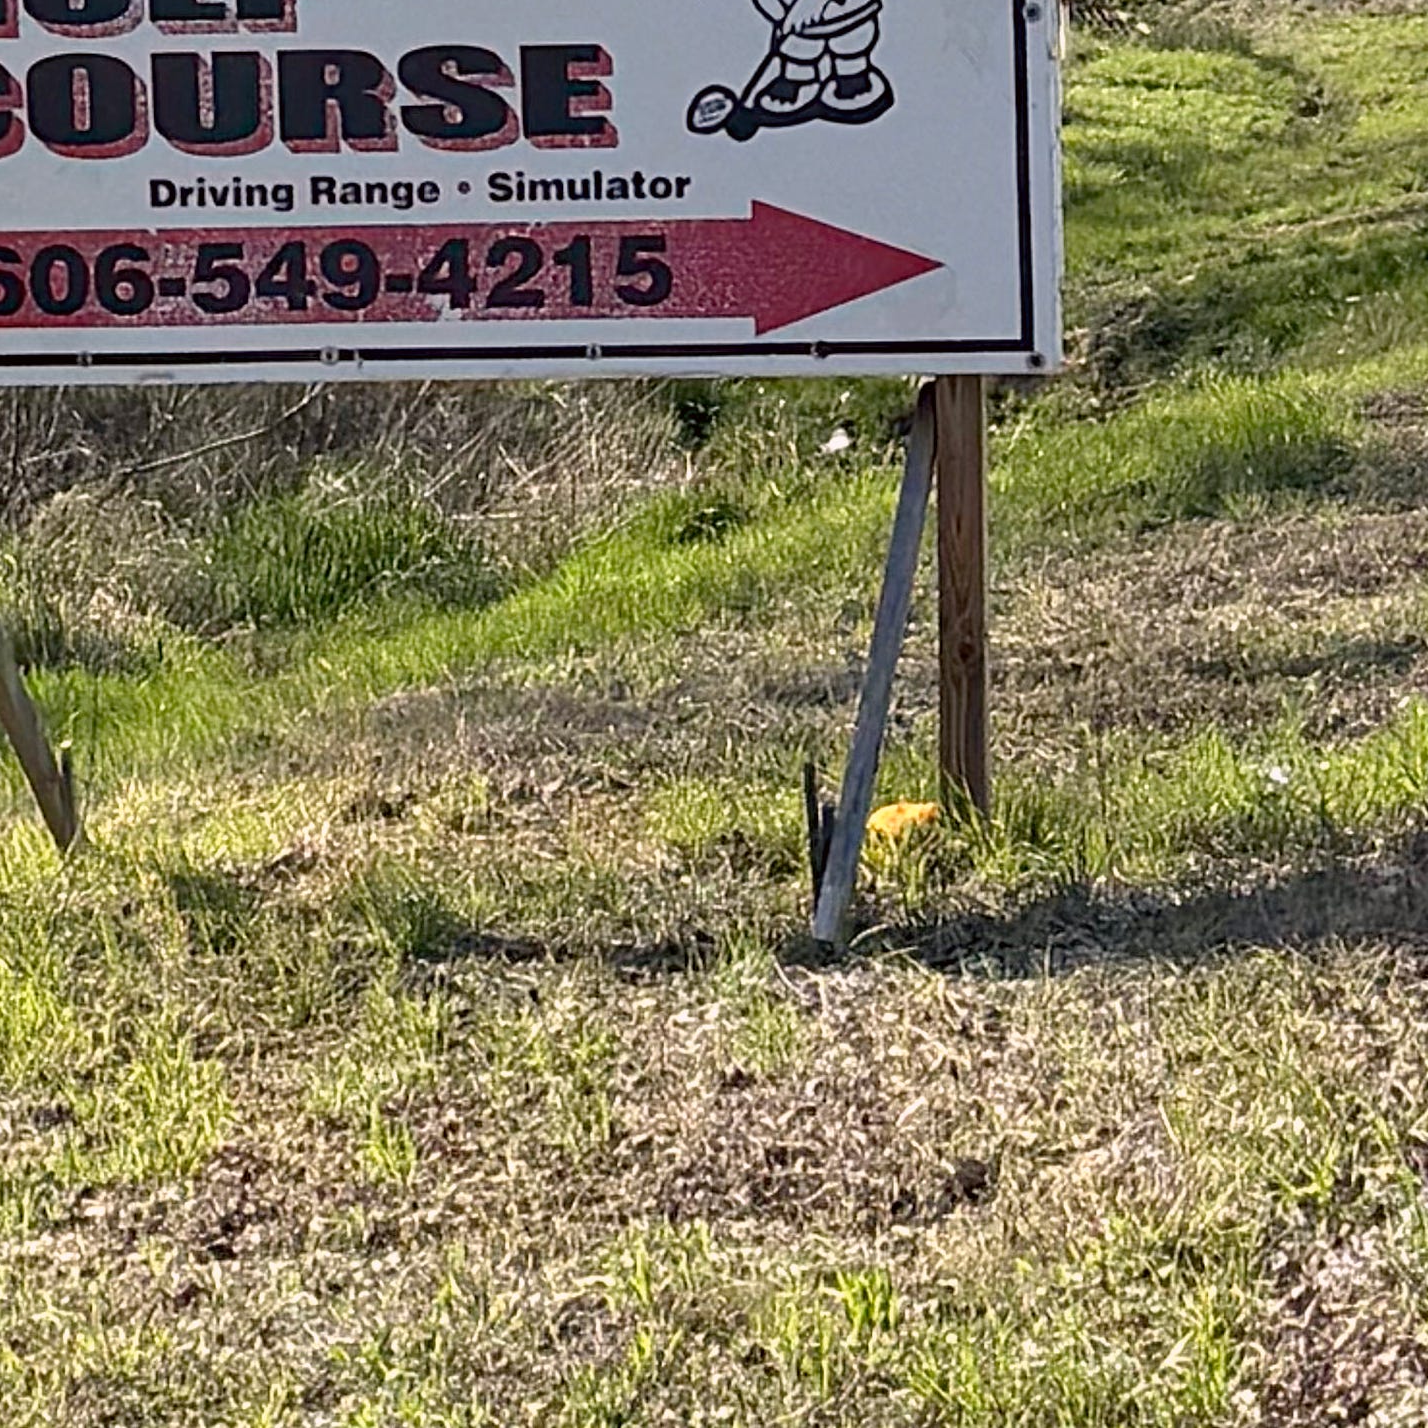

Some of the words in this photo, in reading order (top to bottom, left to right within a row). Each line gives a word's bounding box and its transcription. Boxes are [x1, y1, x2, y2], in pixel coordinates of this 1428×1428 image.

[149, 178, 294, 211] Driving
[310, 176, 441, 209] Range
[488, 171, 691, 202] Simulator
